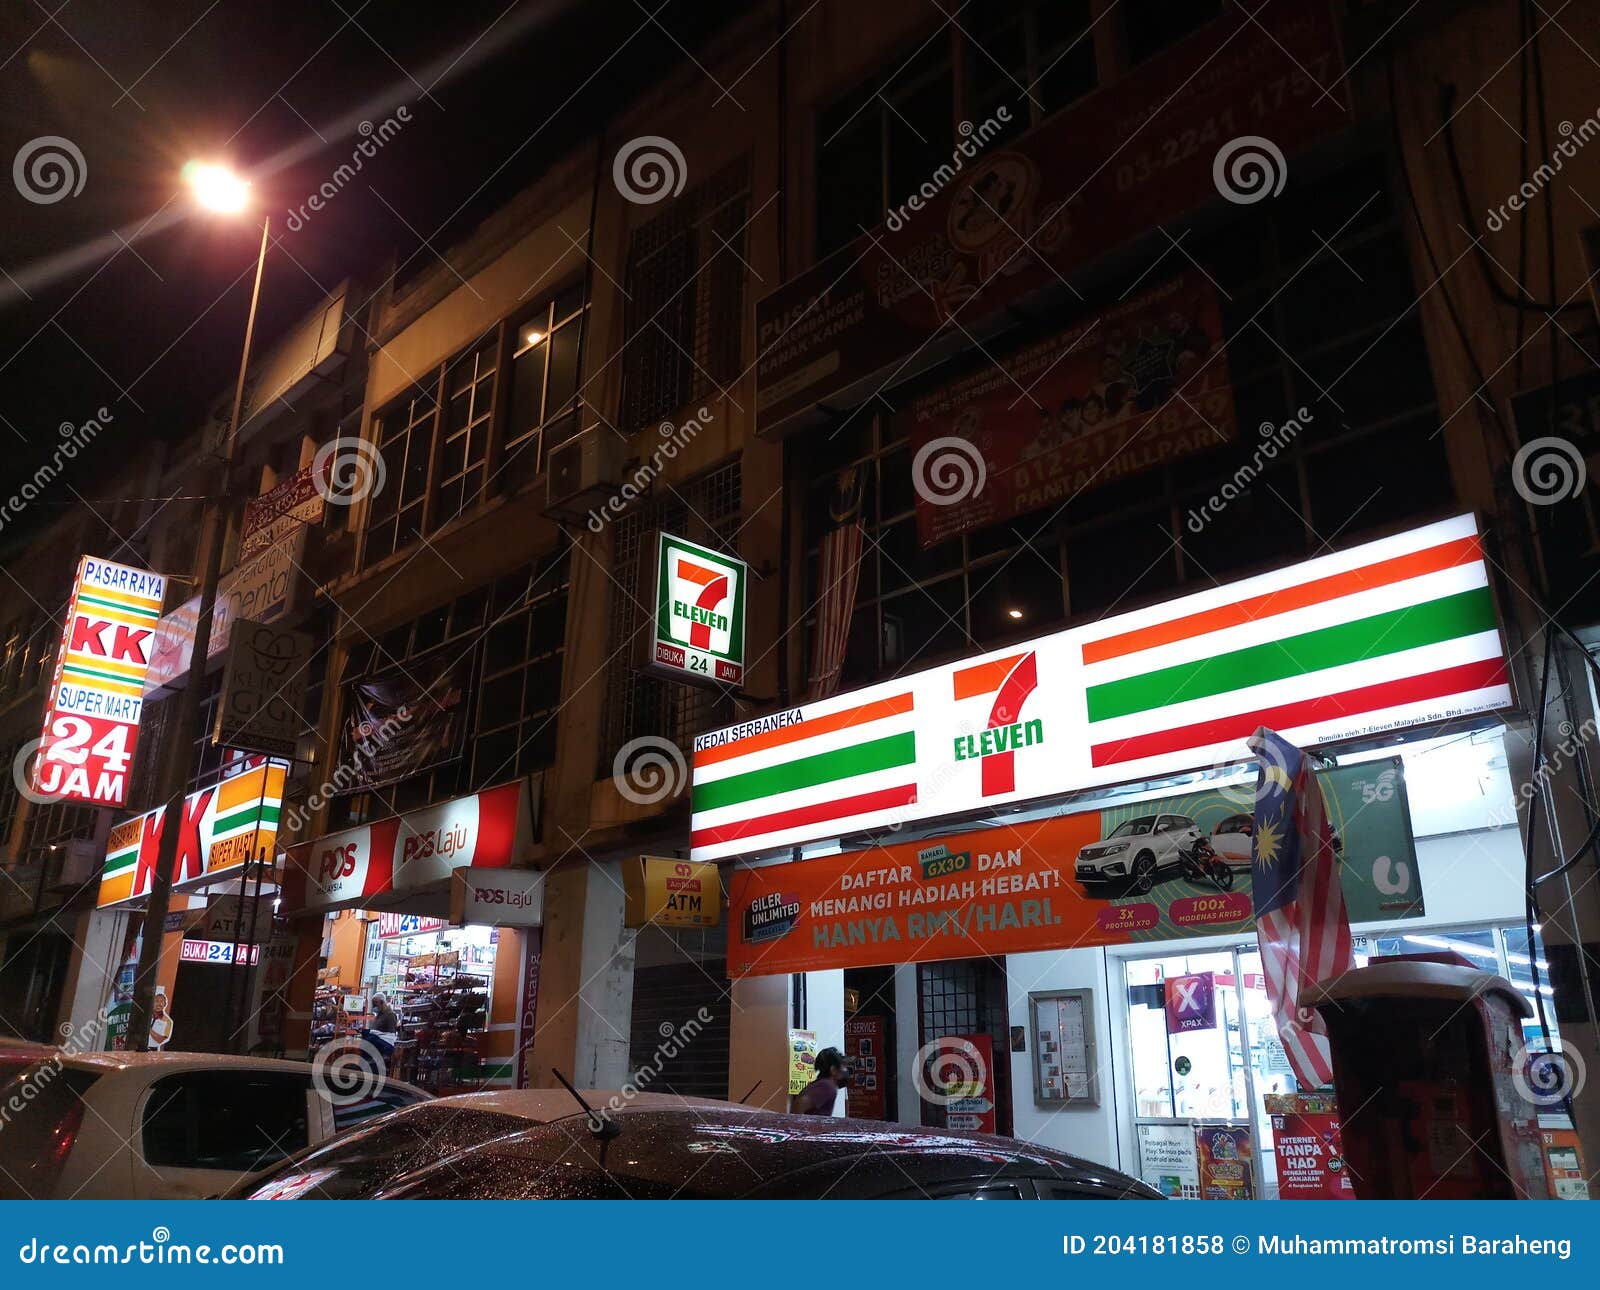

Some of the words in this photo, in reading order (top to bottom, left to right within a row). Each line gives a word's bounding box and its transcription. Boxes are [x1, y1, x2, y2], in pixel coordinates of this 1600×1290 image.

[677, 559, 728, 650] 7
[70, 616, 152, 665] KK
[657, 646, 684, 664] DIBUKA
[690, 656, 708, 673] 24
[722, 666, 736, 679] JAM
[58, 687, 101, 713] SUPER
[105, 695, 141, 722] MART
[695, 727, 730, 752] KEDAI
[731, 708, 804, 743] SERBANEKA
[953, 650, 1039, 797] 7
[1318, 732, 1344, 743] Dimiliki
[1362, 722, 1393, 734] 7-Eleven
[1393, 716, 1426, 728] Malaysia
[1427, 711, 1445, 721] Sdn.
[1446, 708, 1464, 718] Bhd.
[47, 716, 131, 772] 24
[40, 764, 123, 803] JAM
[1362, 781, 1394, 804] 5G
[209, 840, 232, 867] SUPER
[436, 823, 467, 858] Laju
[841, 866, 912, 890] DAFTAR
[927, 856, 966, 877] GX30
[977, 849, 1022, 872] DAN
[506, 888, 532, 907] Laju
[670, 881, 698, 890] AmBank
[810, 892, 892, 918] MENANGI
[899, 879, 975, 907] HADIAH
[982, 869, 1060, 896] HEBAT!
[666, 894, 702, 912] ATM
[752, 892, 782, 912] GILER
[752, 902, 800, 926] UNLIMITED
[1105, 919, 1129, 930] PROTON
[1179, 912, 1217, 923] MODENAS
[1219, 909, 1242, 921] KRISS
[813, 916, 900, 949] HANYA
[183, 942, 206, 960] BUKA
[208, 944, 231, 961] 24
[522, 953, 541, 1030] Datang
[853, 1022, 876, 1033] SERVICE
[1180, 1018, 1202, 1029] XPAX
[1277, 1144, 1323, 1157] TANPA
[1279, 1136, 1317, 1144] INTERNET
[1286, 1157, 1317, 1169] HAD
